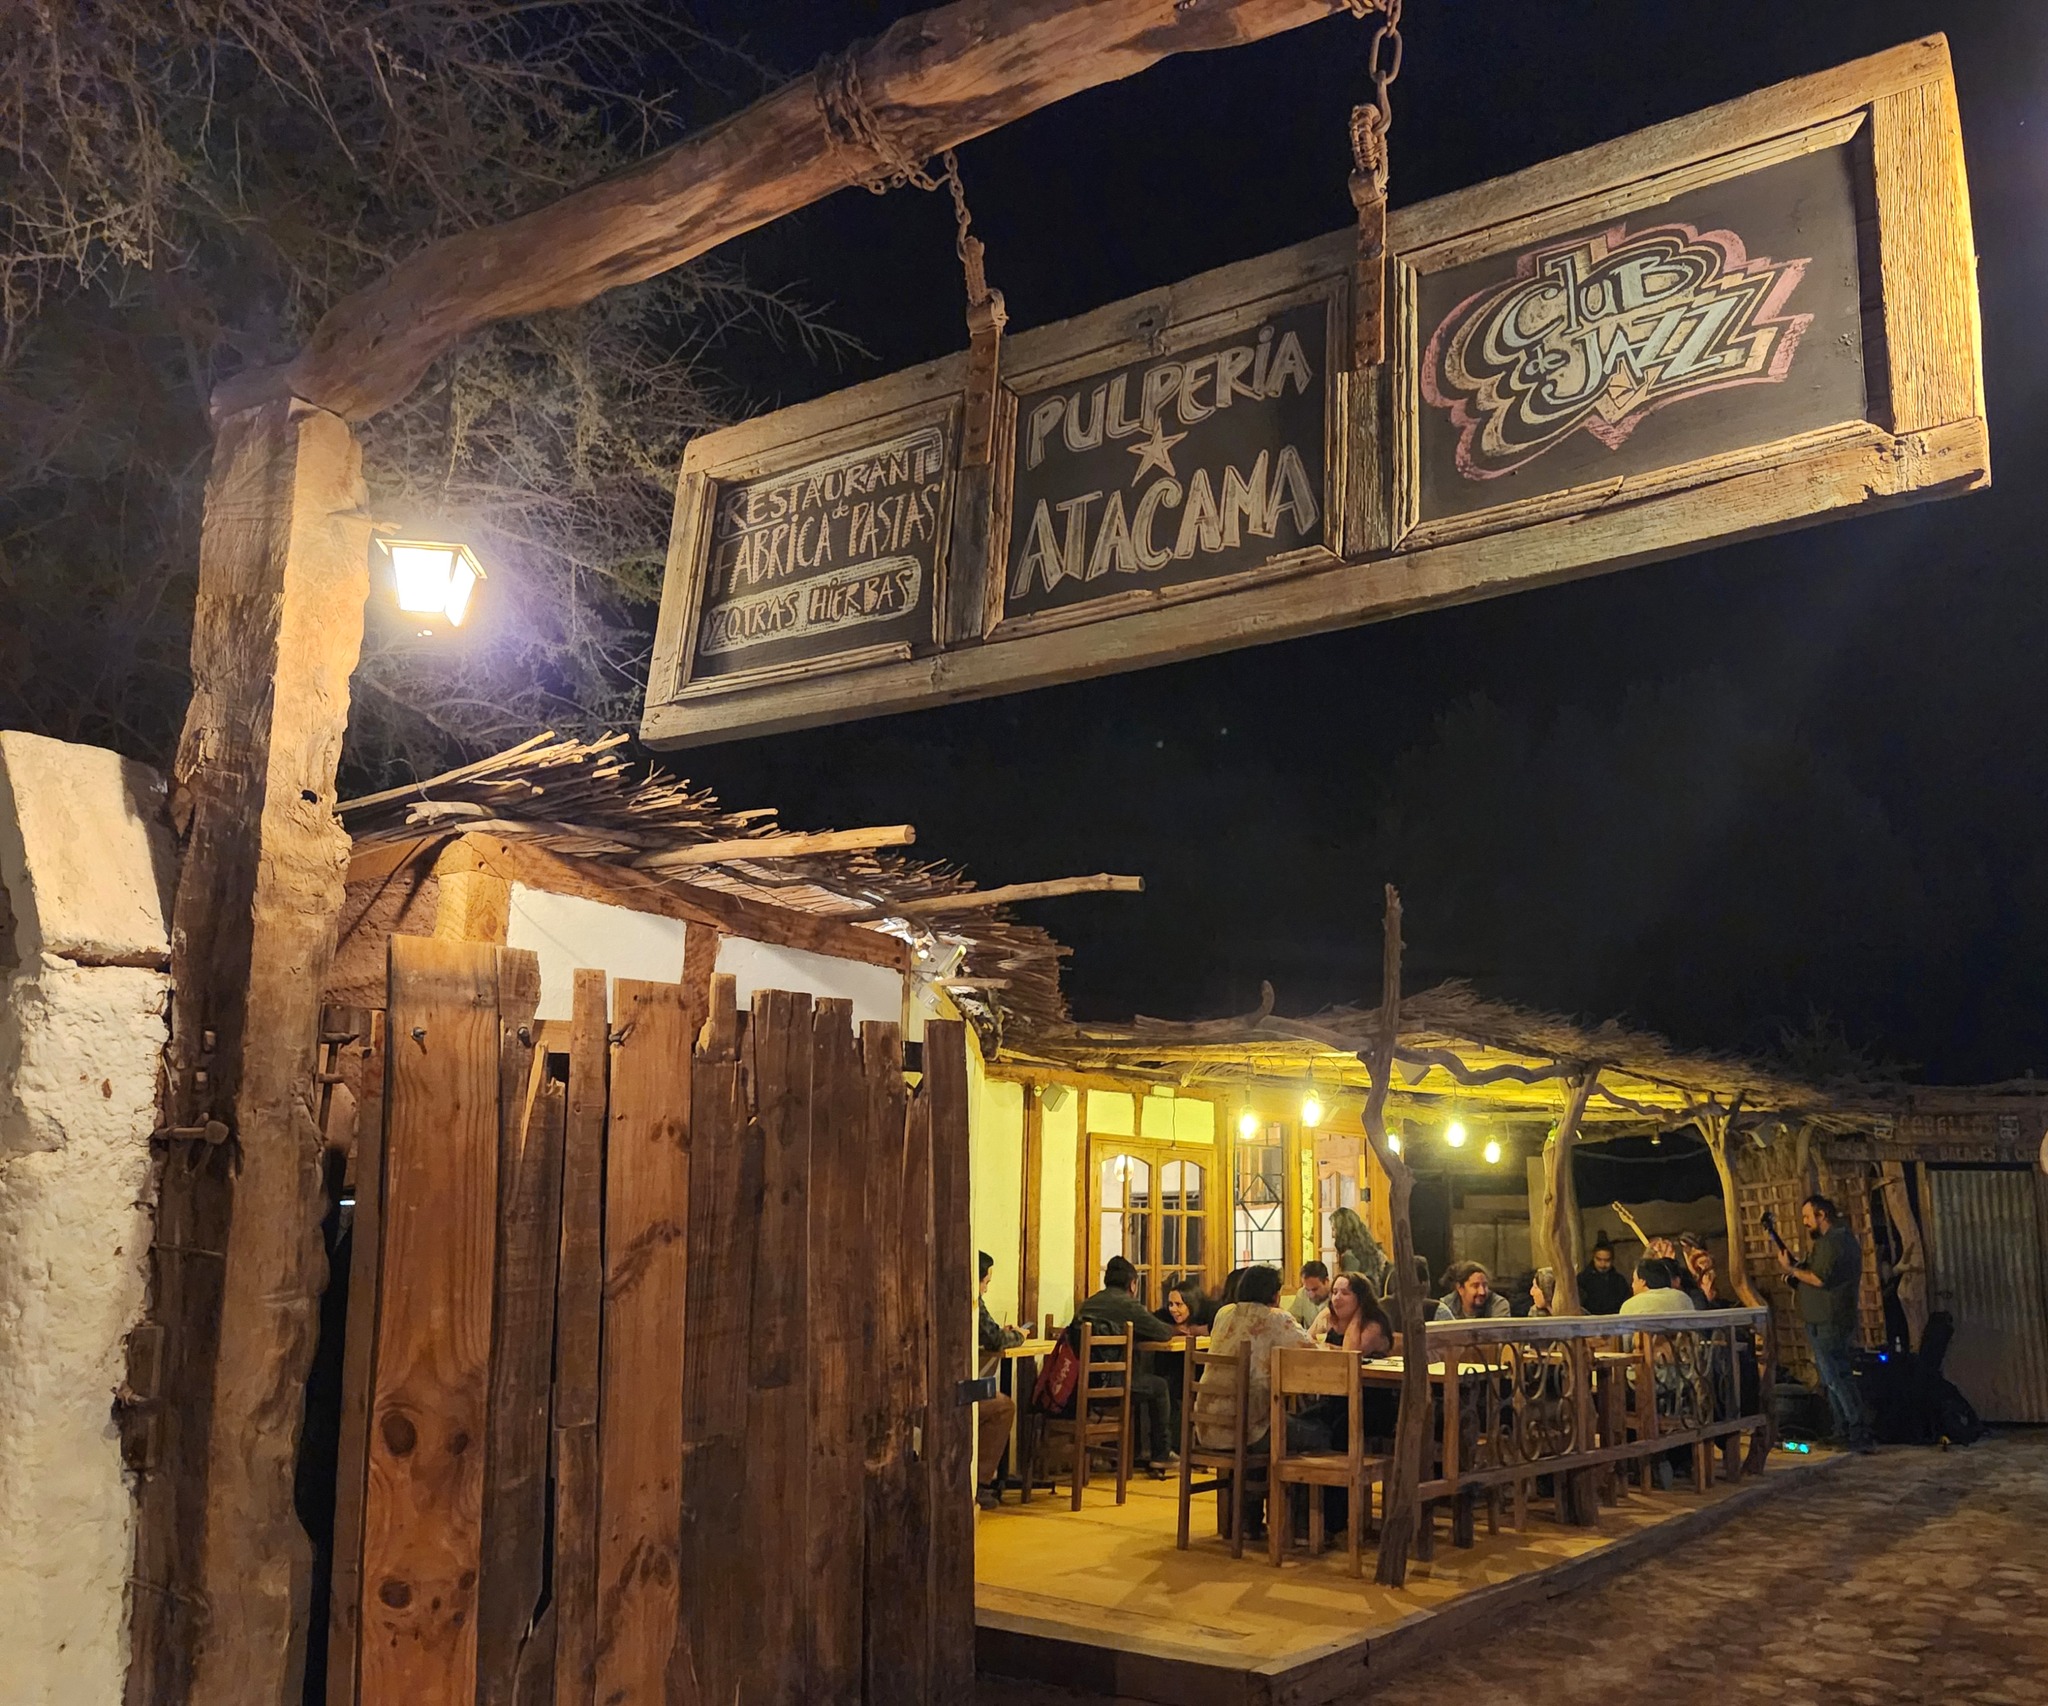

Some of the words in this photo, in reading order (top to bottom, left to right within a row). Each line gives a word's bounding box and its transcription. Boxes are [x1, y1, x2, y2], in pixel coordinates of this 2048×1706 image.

[1525, 346, 1566, 376] de
[1544, 288, 1754, 404] JAZZ
[720, 446, 932, 534] RESTAURANT
[832, 499, 849, 519] de
[849, 484, 940, 558] PASTAS
[1010, 444, 1319, 599] ATACAMA
